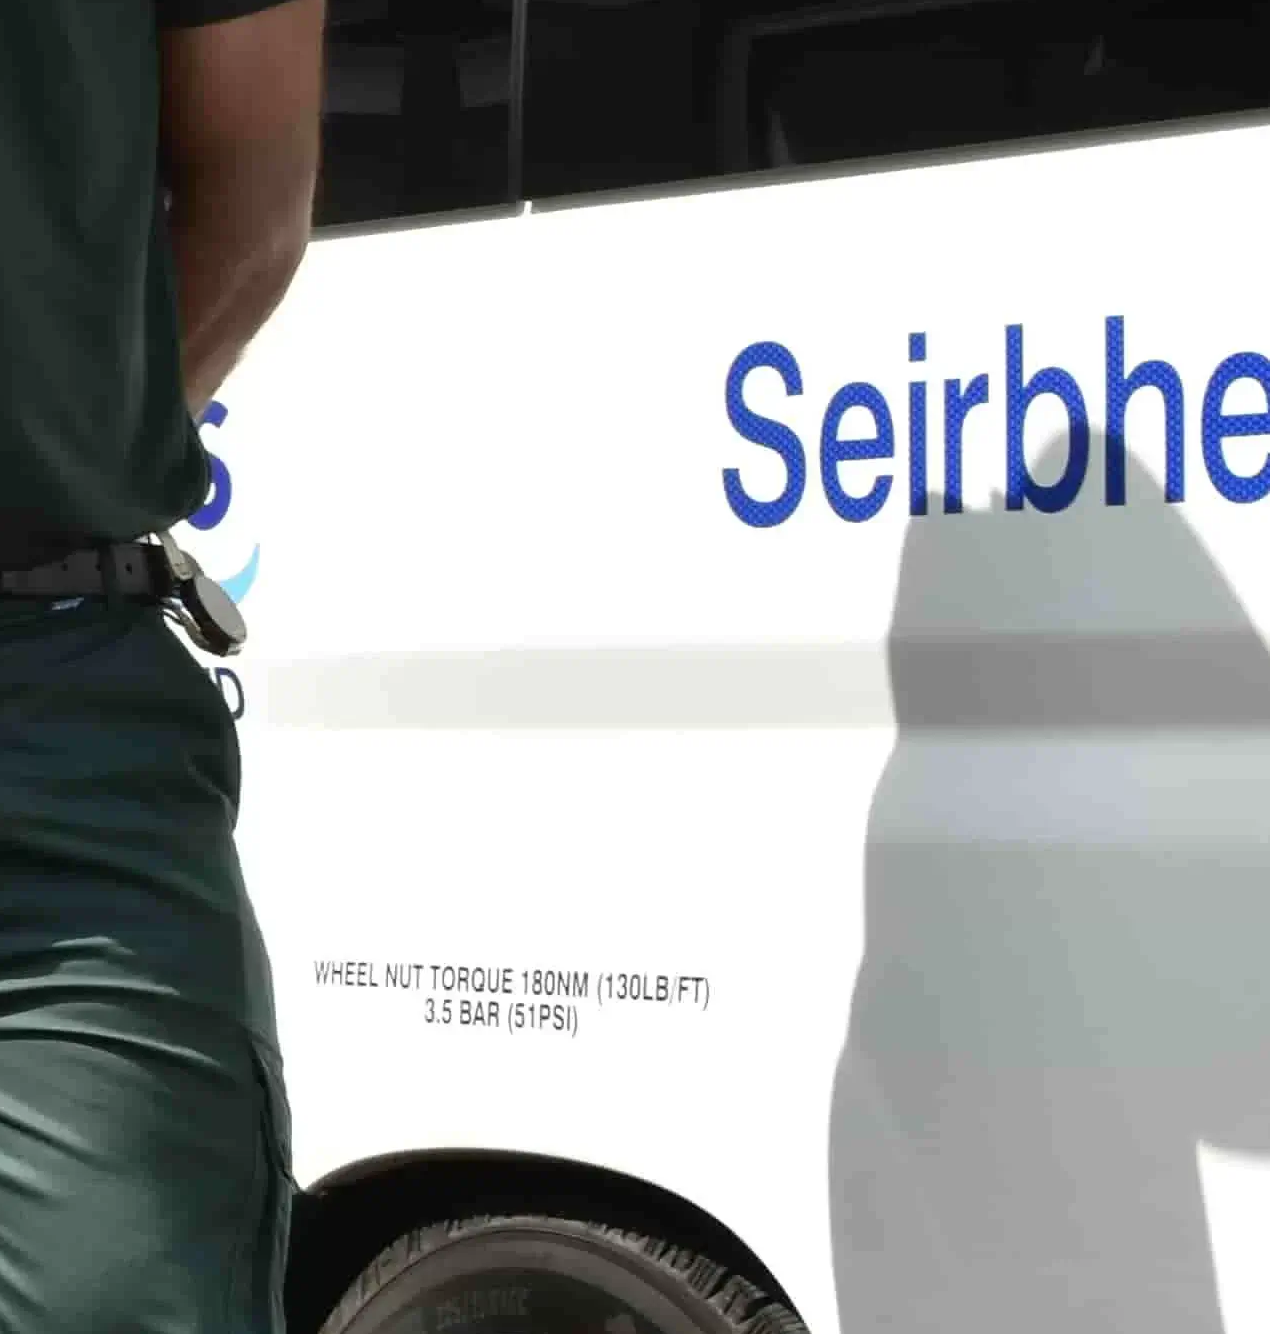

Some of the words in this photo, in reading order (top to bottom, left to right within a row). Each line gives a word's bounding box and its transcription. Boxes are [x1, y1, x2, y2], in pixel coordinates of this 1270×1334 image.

[722, 315, 1270, 529] Seirbhe
[313, 960, 379, 988] WHEEL
[384, 962, 425, 990] NUT
[430, 964, 514, 995] TORQUE
[521, 969, 590, 998] 180NM
[596, 971, 711, 1012] (130LB/FT)
[424, 997, 453, 1025] 3.5
[459, 999, 501, 1028] BAR
[507, 1002, 579, 1040] (51PSI)
